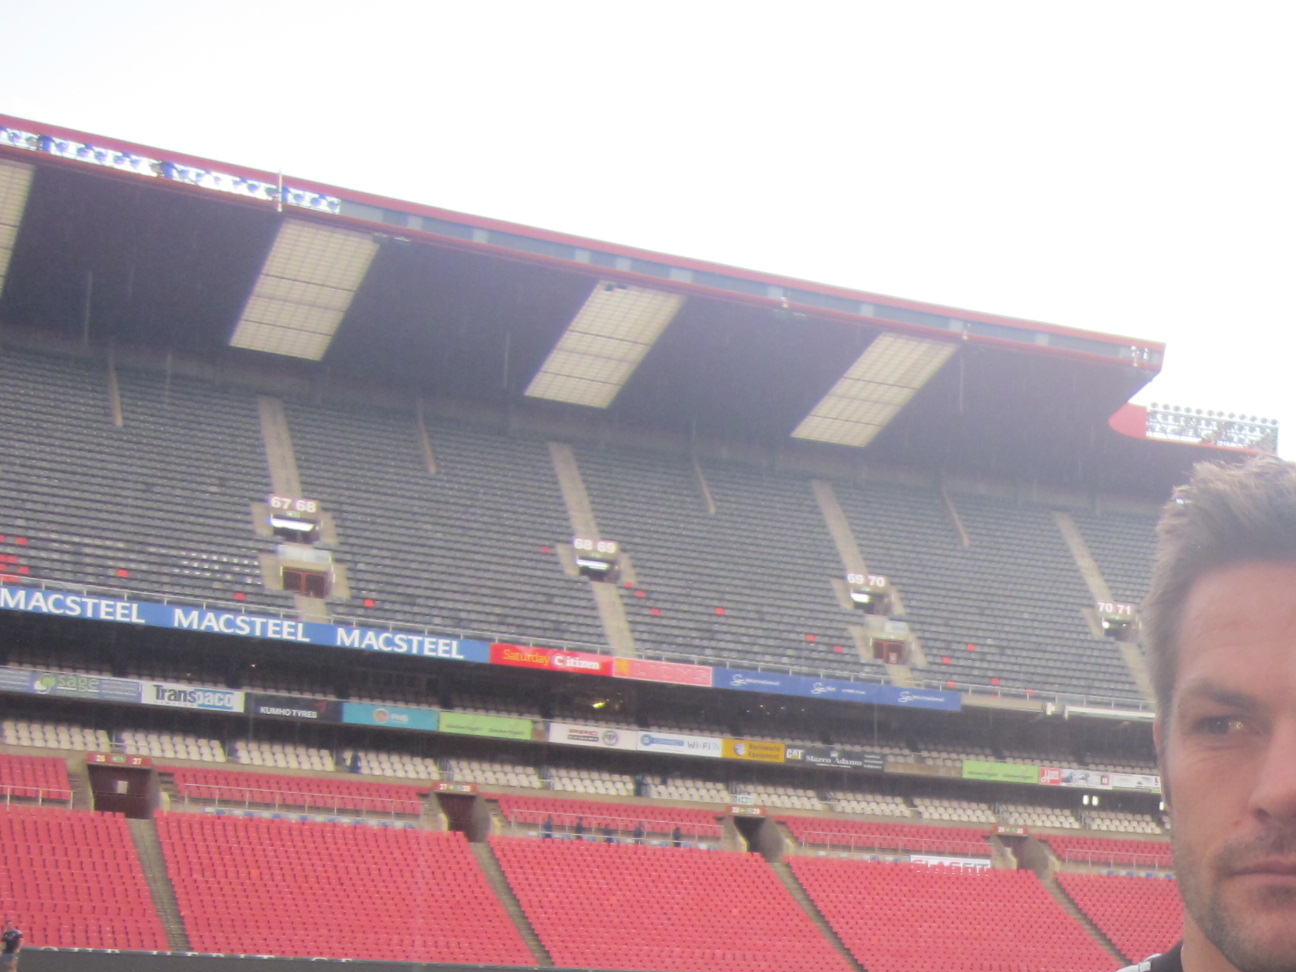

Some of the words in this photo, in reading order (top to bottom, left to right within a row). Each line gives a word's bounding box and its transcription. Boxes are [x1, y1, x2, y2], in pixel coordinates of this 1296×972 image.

[271, 496, 292, 509] 67
[296, 499, 317, 513] 68
[868, 575, 885, 587] 70
[0, 587, 146, 625] MACSTEEL
[1097, 602, 1113, 613] 70
[1116, 603, 1131, 615] 71
[174, 608, 310, 643] MACSTEEL
[336, 626, 464, 660] MACSTEEL
[502, 649, 551, 666] Saturday
[58, 674, 100, 692] sage
[260, 706, 291, 716] KUMHO
[292, 708, 318, 719] TYRES
[786, 749, 804, 760] CAT
